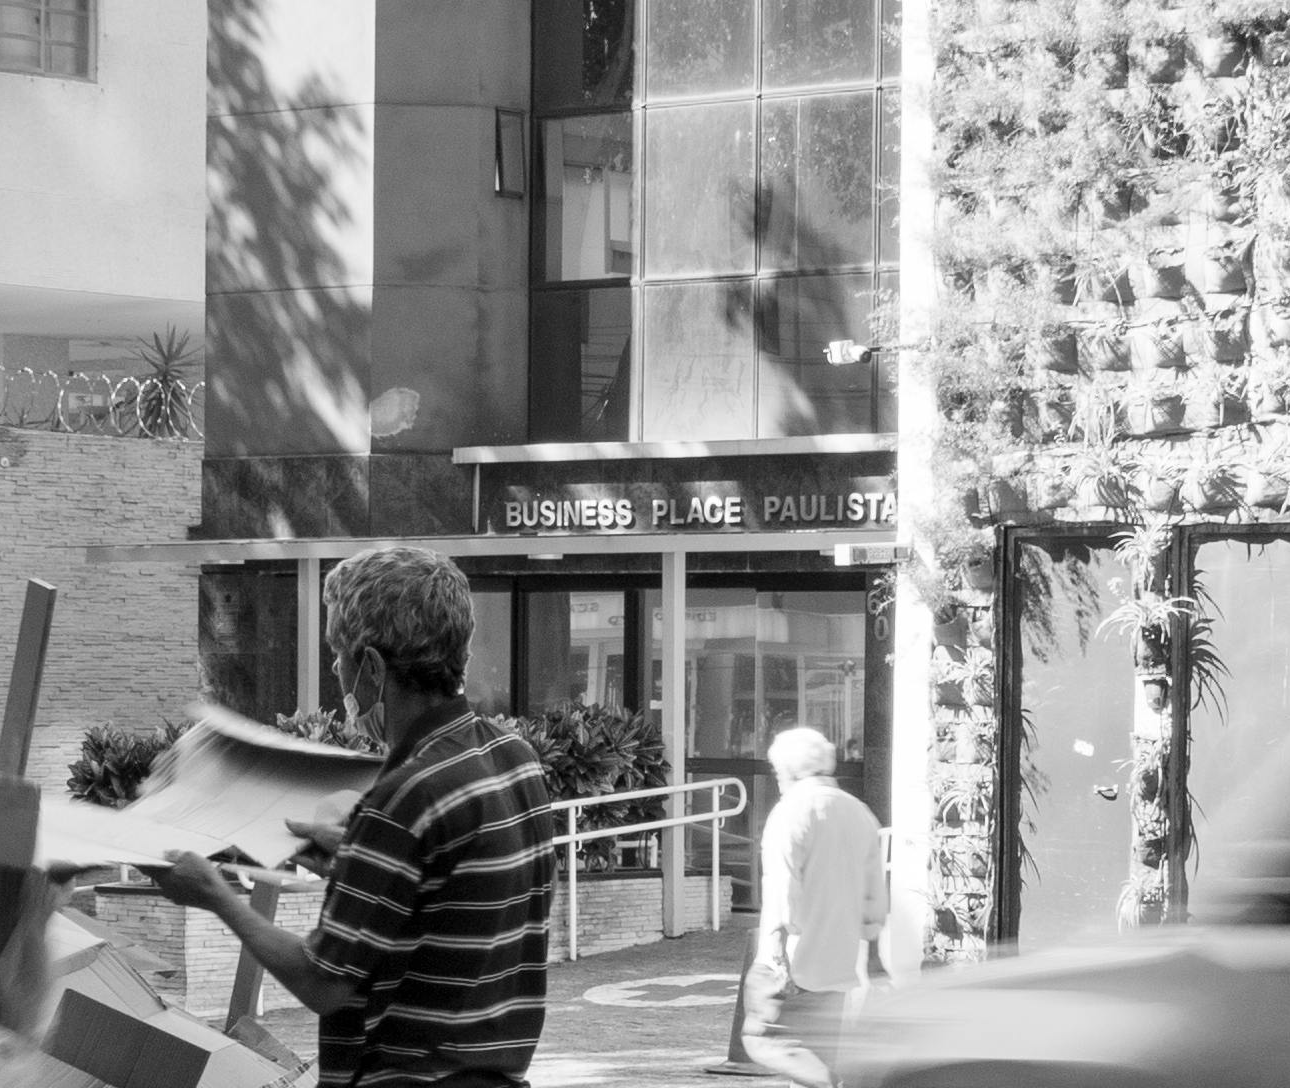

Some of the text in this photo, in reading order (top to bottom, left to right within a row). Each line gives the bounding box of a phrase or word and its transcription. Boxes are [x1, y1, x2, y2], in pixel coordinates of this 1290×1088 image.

[506, 493, 898, 527] BUSINESS PLACE PAULISTA
